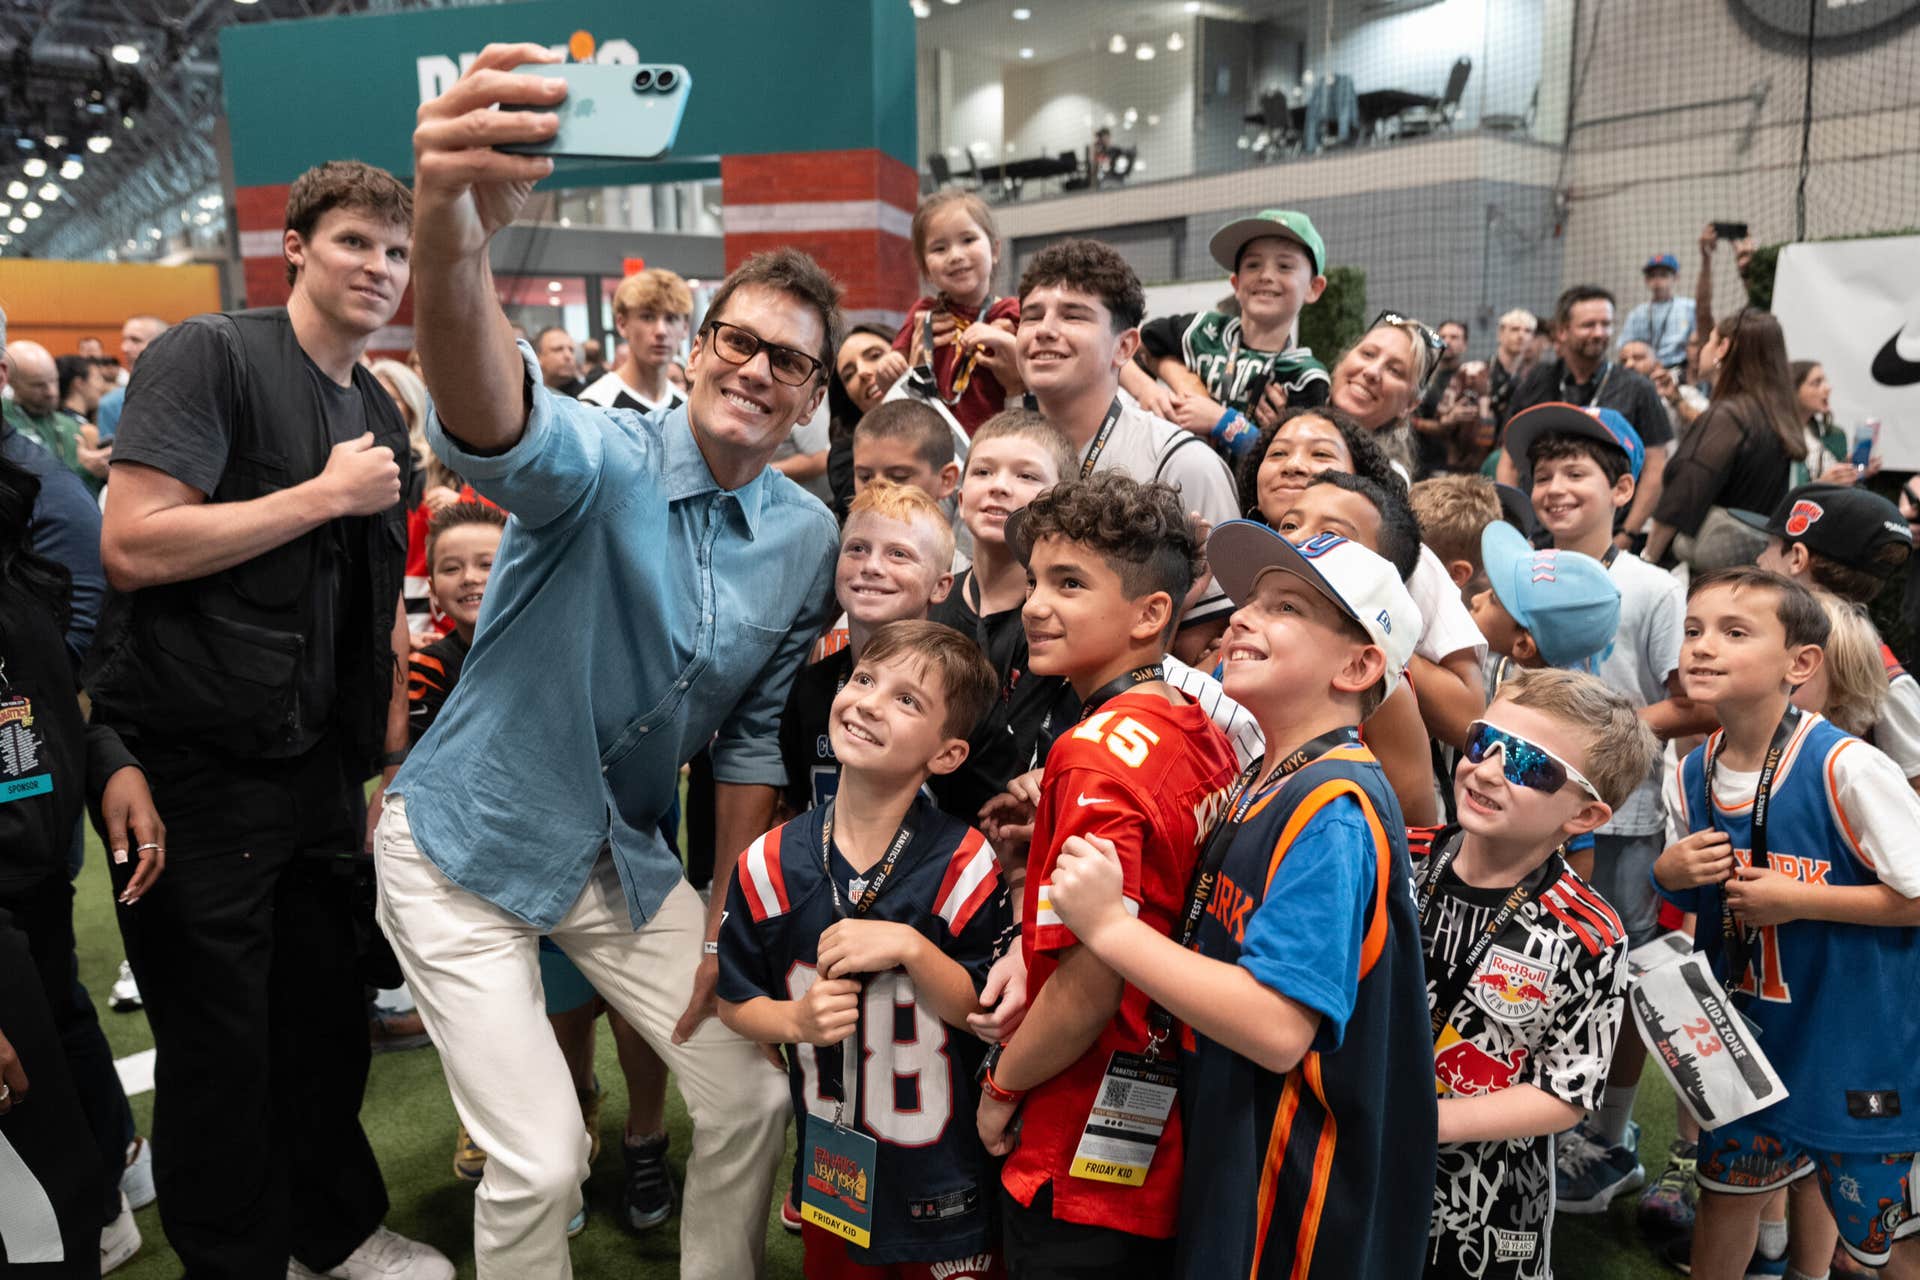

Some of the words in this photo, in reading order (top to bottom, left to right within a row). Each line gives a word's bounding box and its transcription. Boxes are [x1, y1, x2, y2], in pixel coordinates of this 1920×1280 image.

[1071, 710, 1160, 768] 15
[1283, 751, 1309, 773] NYC
[1767, 749, 1781, 769] NYC
[8, 780, 39, 794] SPONSOR
[1762, 768, 1774, 785] FEST
[1755, 794, 1766, 826] FANATICS
[822, 821, 831, 845] NYC
[887, 829, 911, 864] FANATICS
[1429, 851, 1450, 884] FANATICS
[872, 872, 886, 891] FEST
[1196, 872, 1213, 900] NYC
[857, 889, 877, 912] NYC
[1190, 899, 1203, 920] FEST
[1419, 893, 1430, 911] FEST
[1465, 932, 1492, 966] FANATICS
[1494, 906, 1511, 925] FEST
[1505, 887, 1529, 910] NYC
[1486, 992, 1505, 1010] NEW
[1507, 1001, 1533, 1015] YORK
[1432, 1007, 1447, 1031] NYC
[1702, 996, 1727, 1027] KIDS
[1719, 1026, 1748, 1060] ZONE
[1682, 1017, 1722, 1057] 23
[1657, 1040, 1680, 1068] ZACH
[1112, 1066, 1138, 1078] FANATICS
[1145, 1073, 1159, 1081] FEST
[814, 1162, 836, 1182] NEW
[1085, 1162, 1116, 1176] FRIDAY
[1117, 1168, 1133, 1178] KID
[813, 1211, 841, 1230] FRIDAY
[843, 1224, 857, 1238] KID
[1501, 1240, 1510, 1249] 50
[1511, 1241, 1533, 1250] YEARS
[929, 1253, 993, 1280] HOBOKEN
